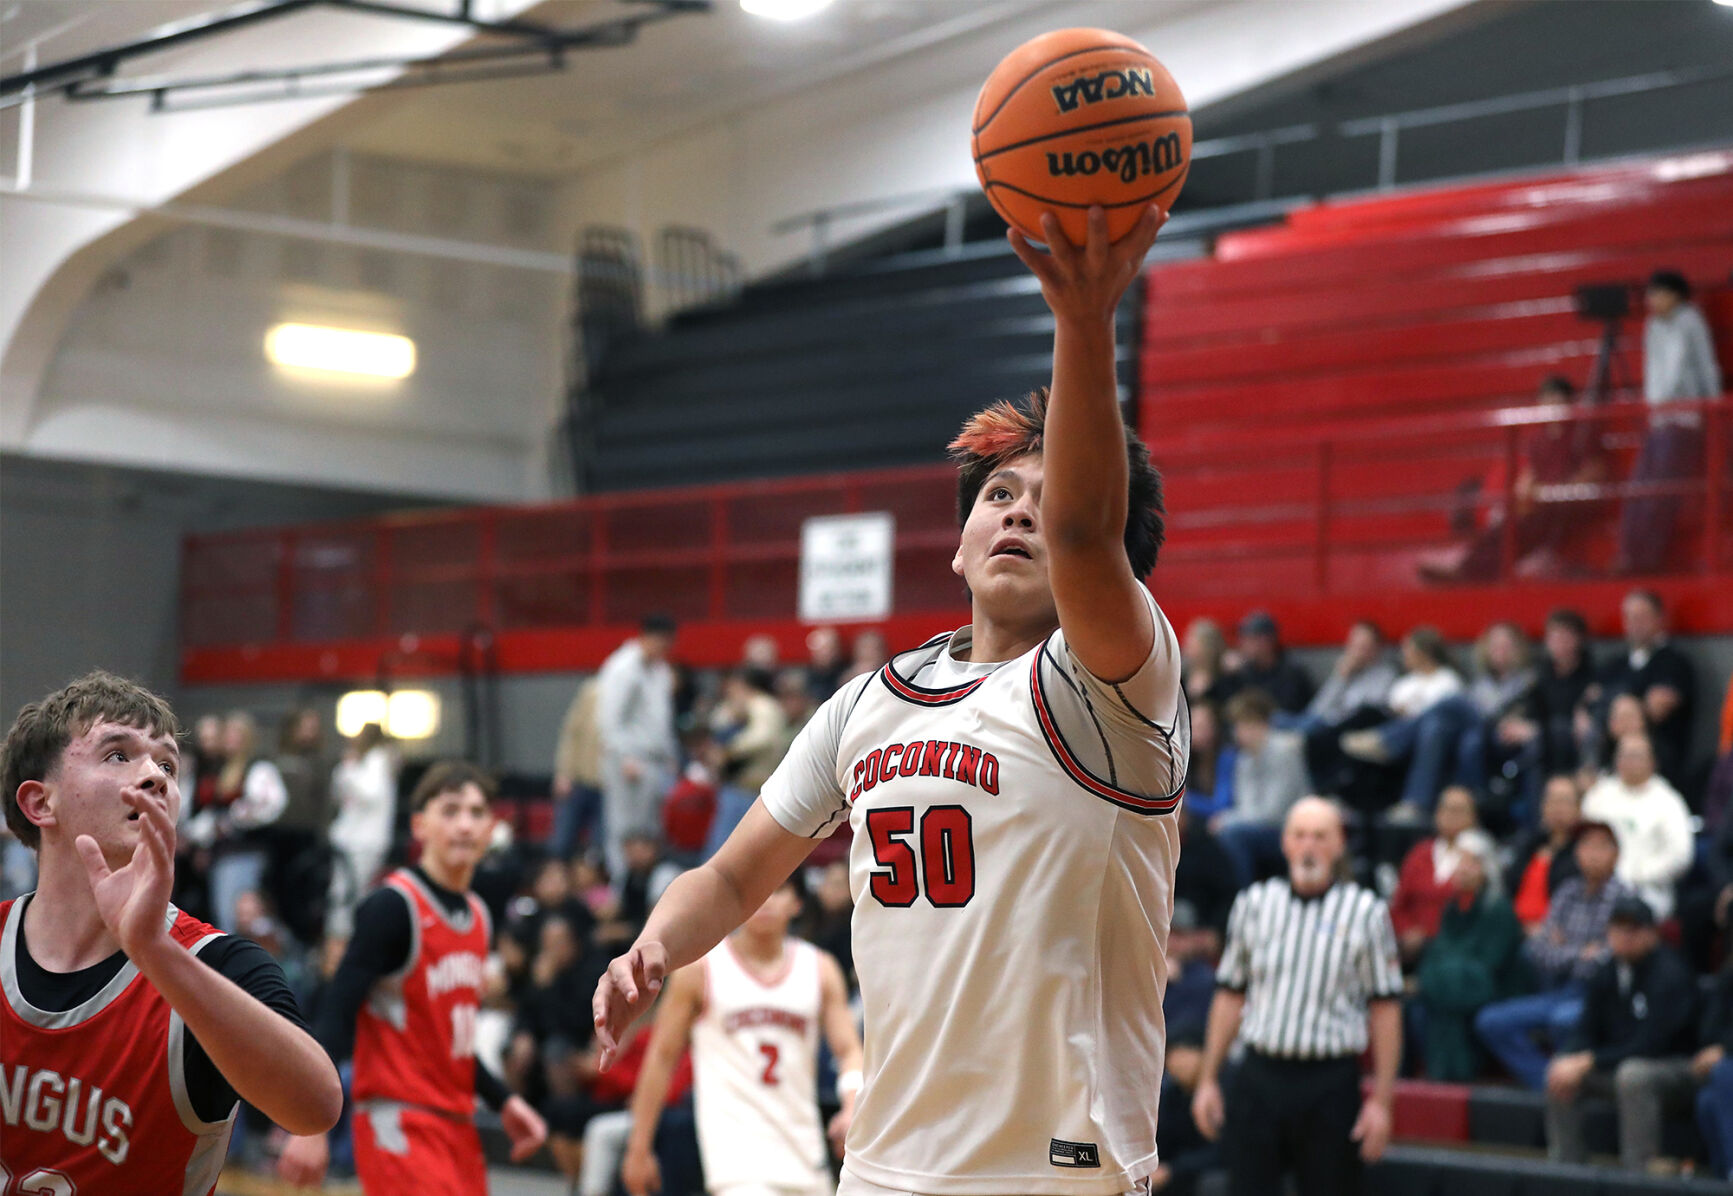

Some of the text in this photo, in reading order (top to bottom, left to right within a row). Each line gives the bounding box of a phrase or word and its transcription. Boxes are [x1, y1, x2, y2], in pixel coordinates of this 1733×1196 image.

[1052, 68, 1154, 114] NCAA
[1046, 131, 1182, 183] Wilson
[850, 740, 999, 803] COCONINO
[866, 805, 976, 908] 50
[759, 1043, 780, 1086] 2
[1078, 1150, 1093, 1162] XL
